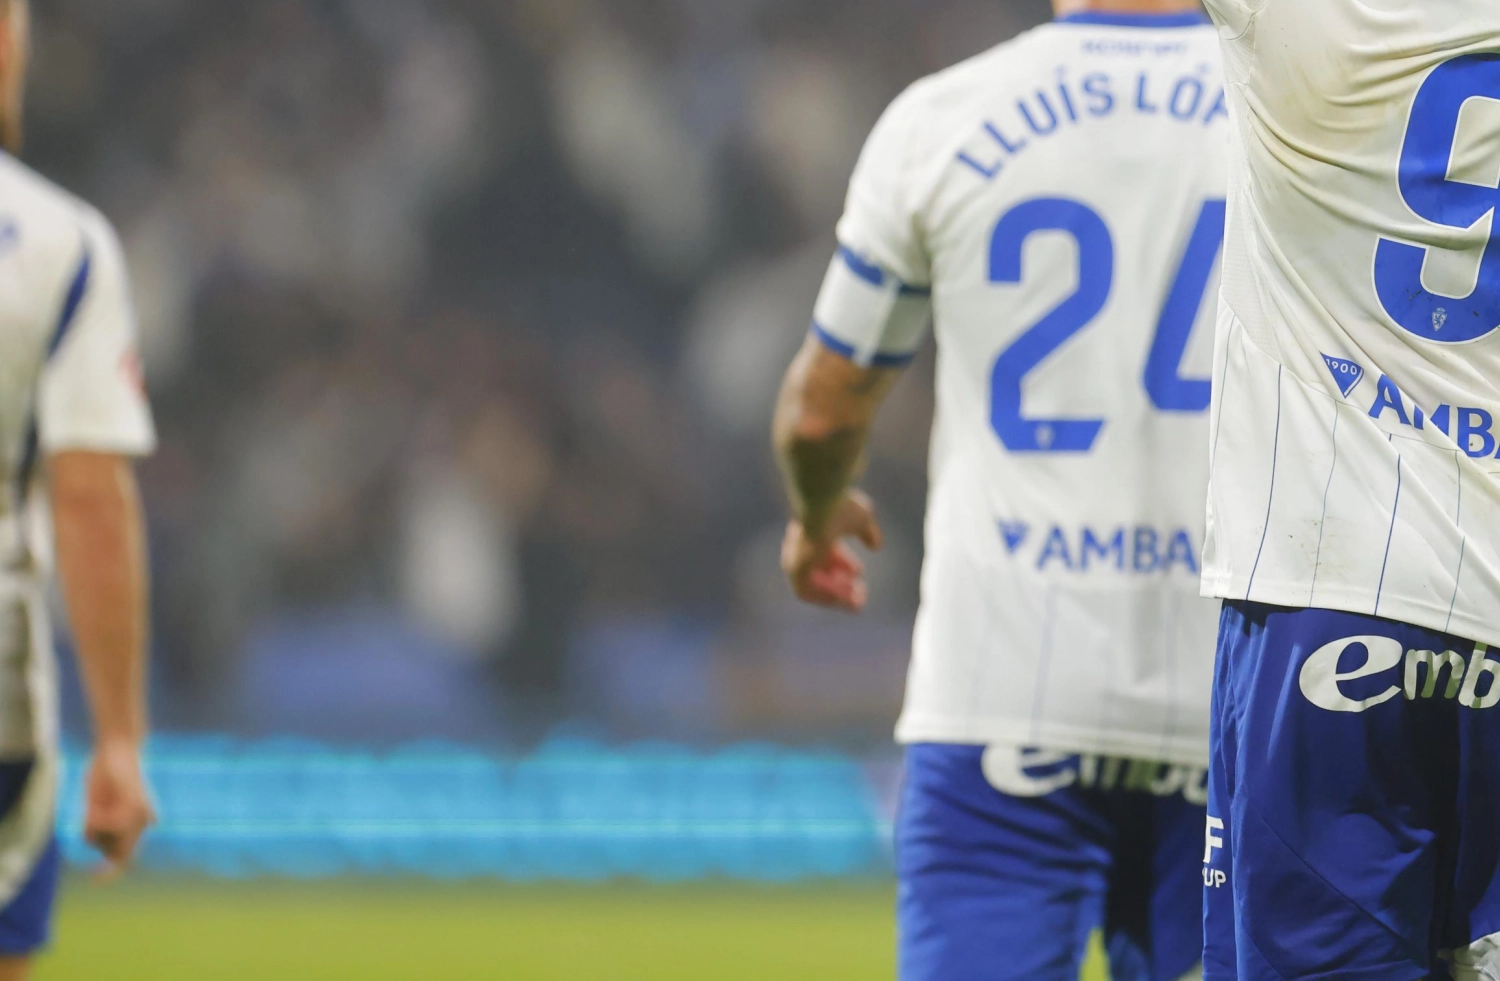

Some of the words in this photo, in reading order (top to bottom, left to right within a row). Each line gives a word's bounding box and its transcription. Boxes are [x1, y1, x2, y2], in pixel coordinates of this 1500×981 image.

[956, 63, 1115, 180] LLUÍS
[1325, 358, 1358, 376] 1900
[1034, 522, 1202, 575] AMBA
